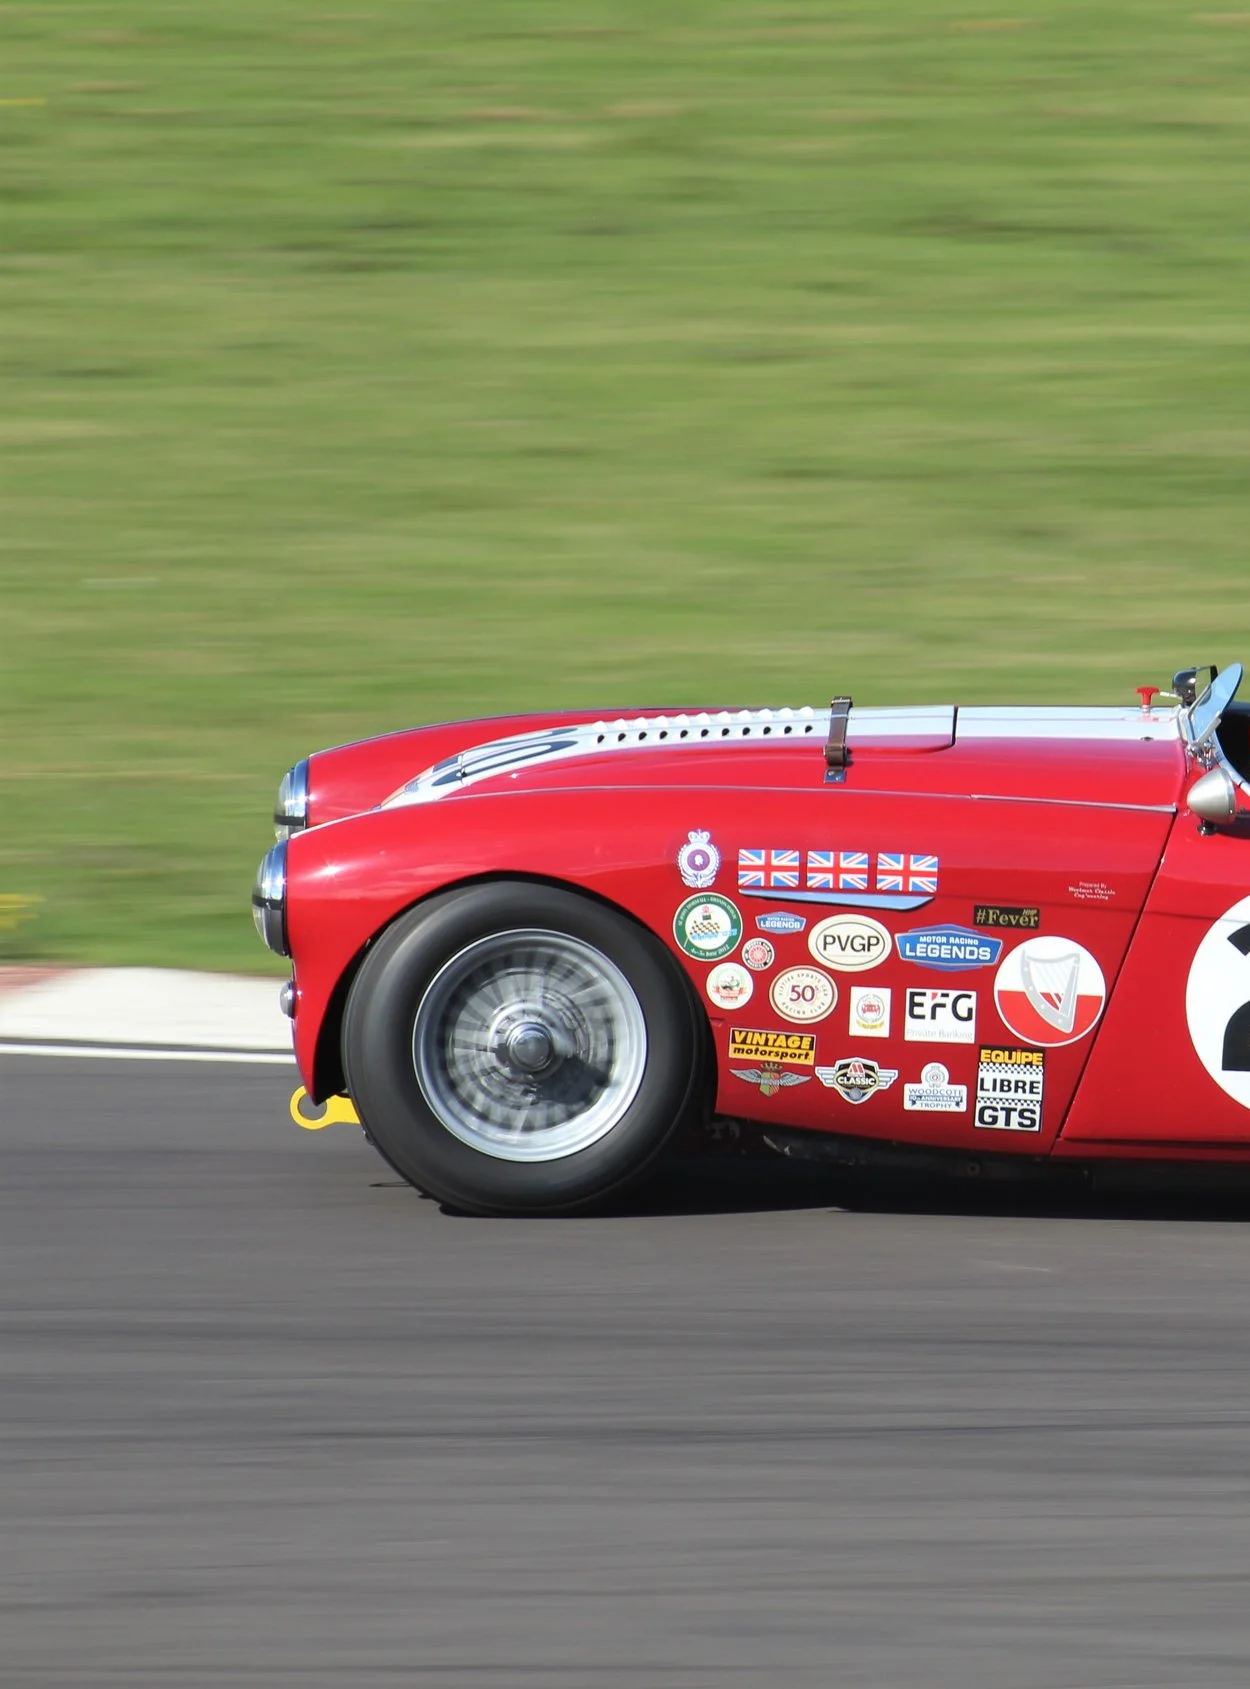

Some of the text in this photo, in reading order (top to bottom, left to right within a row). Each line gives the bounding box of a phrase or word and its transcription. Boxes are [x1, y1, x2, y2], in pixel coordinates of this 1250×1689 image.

[976, 908, 1039, 927] #Fever
[822, 934, 880, 952] PVGP
[919, 936, 979, 945] MOTOR RACING
[905, 943, 991, 960] LEGENDS
[908, 991, 974, 1022] EFG
[733, 1031, 812, 1050] VINTAGE
[906, 1028, 974, 1041] Private Banking
[733, 1046, 810, 1060] motorsport
[980, 1049, 1044, 1066] EQUIPE
[837, 1076, 876, 1087] CLASSIC
[979, 1077, 1041, 1095] LIBRE
[908, 1088, 963, 1096] WOODCOTE
[977, 1105, 1037, 1129] GTS
